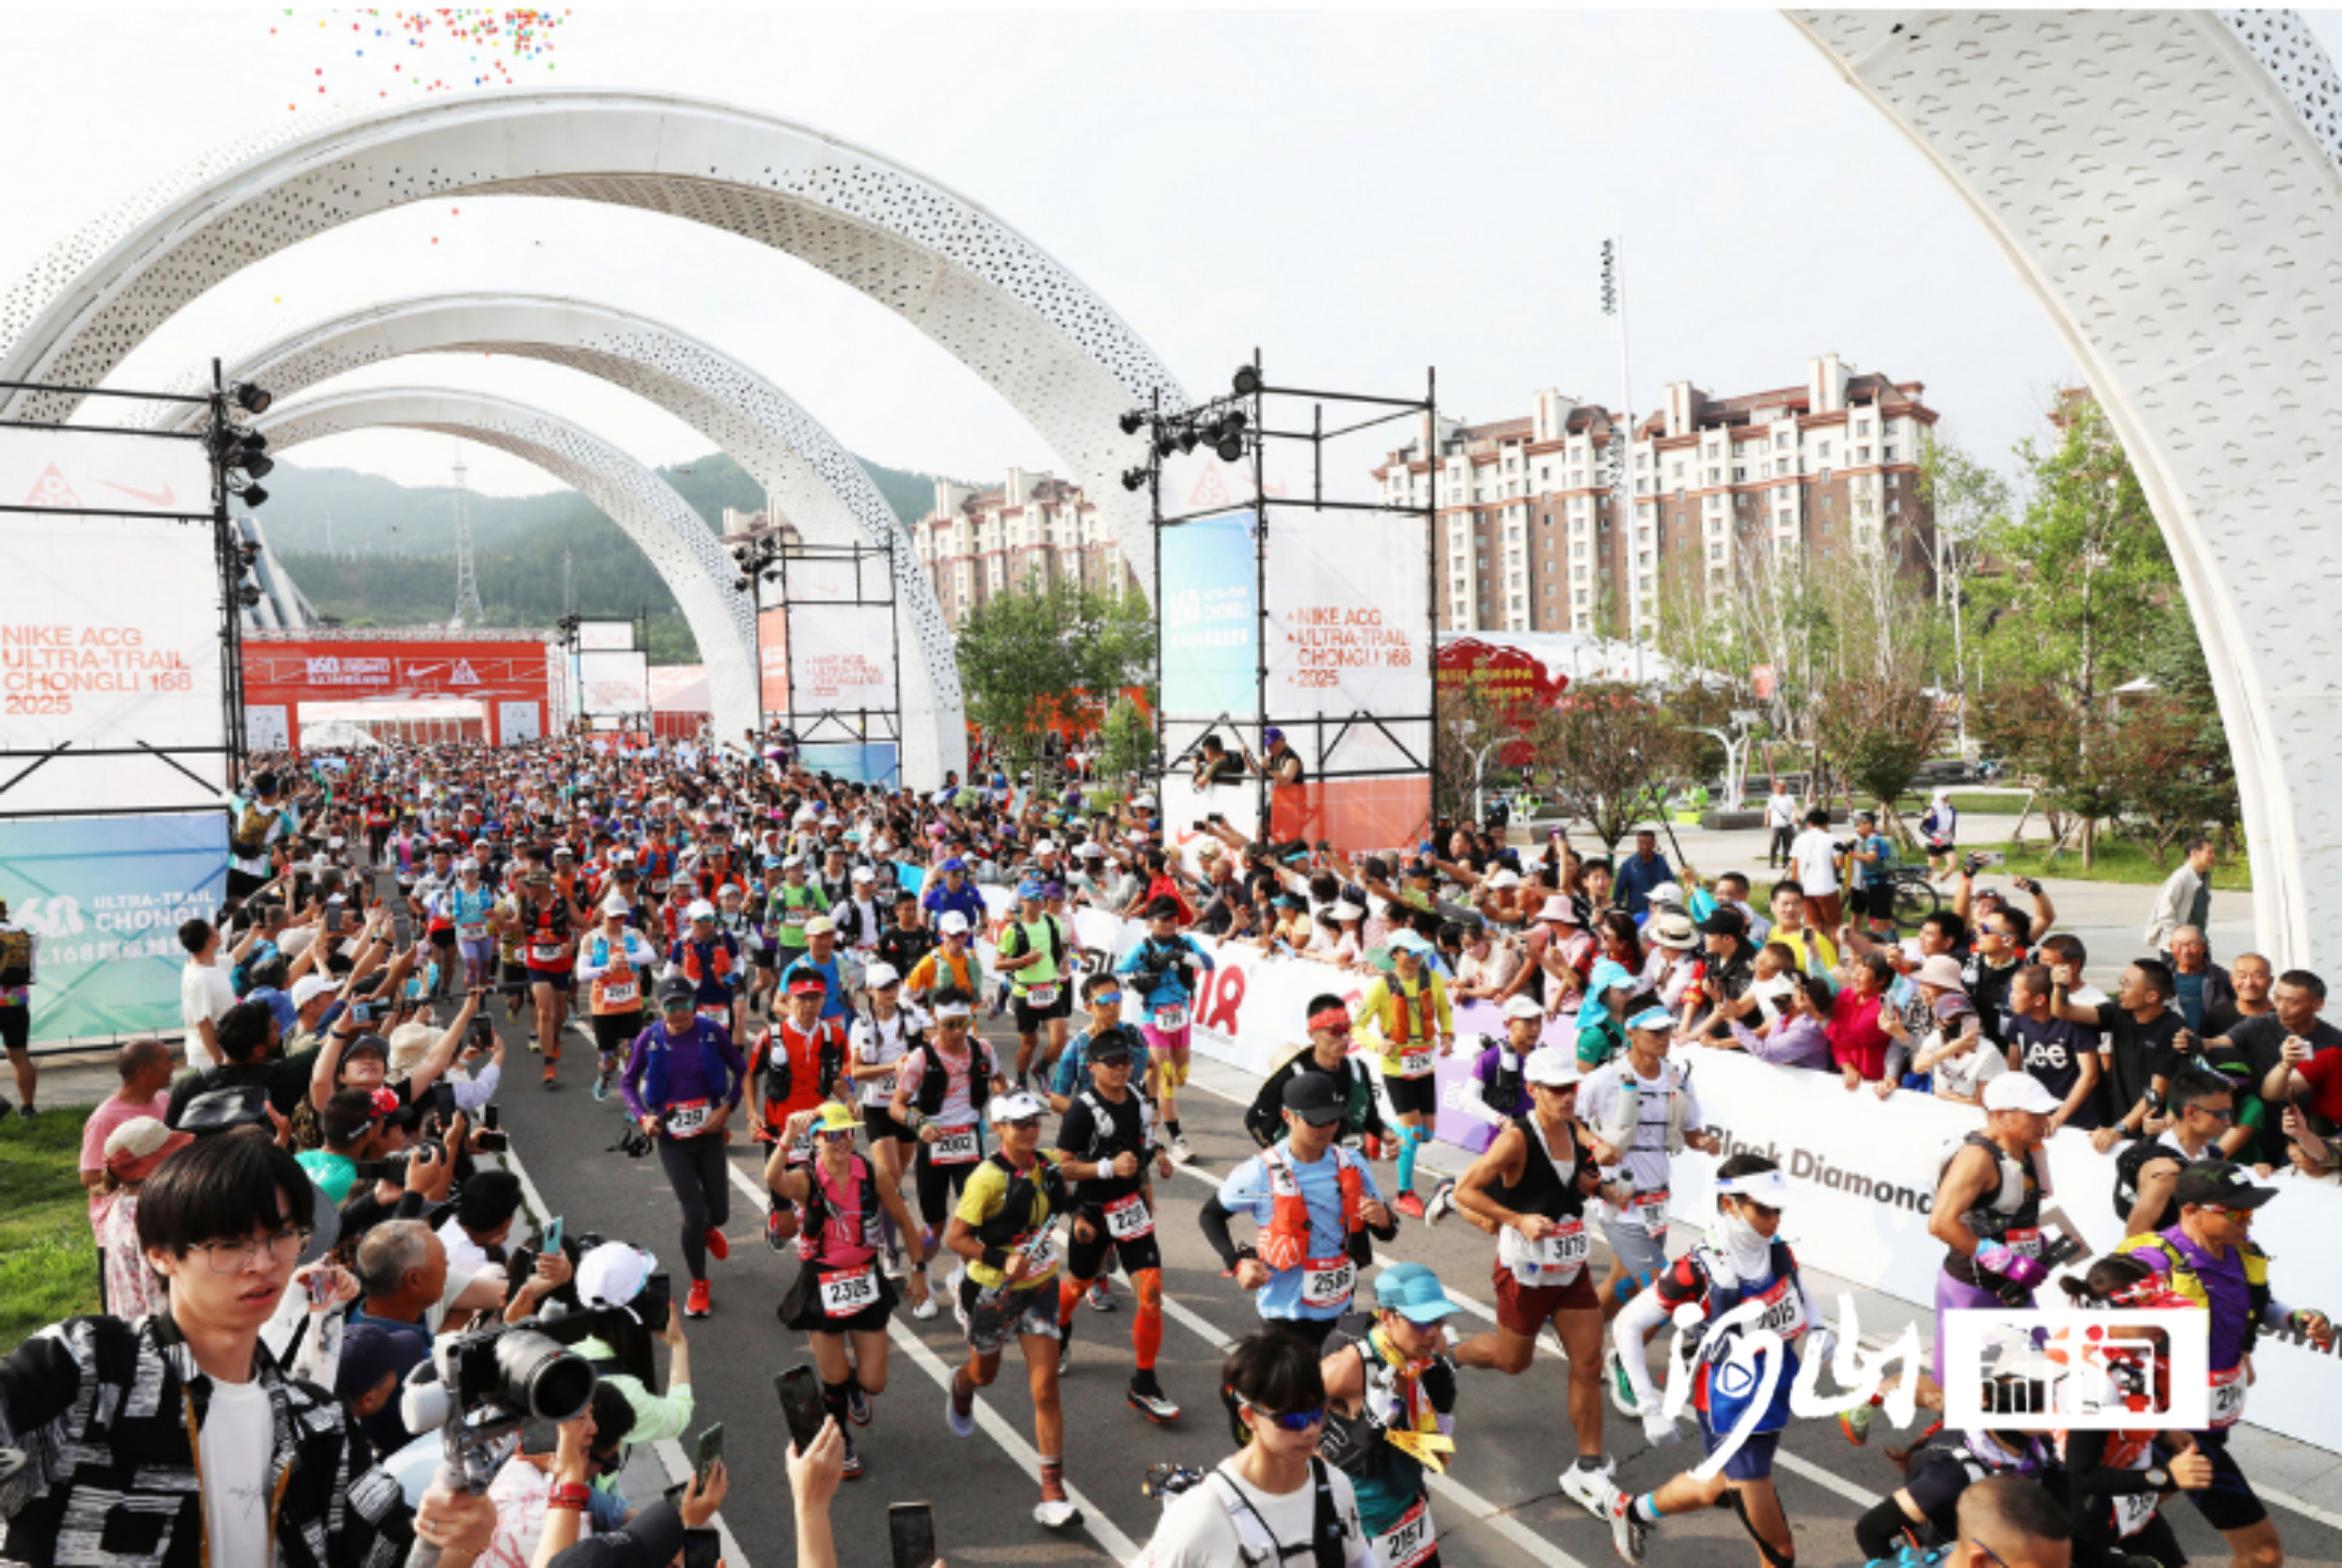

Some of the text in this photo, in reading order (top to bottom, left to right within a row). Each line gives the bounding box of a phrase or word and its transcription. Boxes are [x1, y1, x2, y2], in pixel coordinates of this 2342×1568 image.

[1297, 606, 1382, 626] NIKE ACG
[2, 625, 143, 647] NIKE ACG
[1297, 627, 1410, 647] ULTRA-TRAIL
[2, 648, 191, 670] ULTRA-TRAIL
[1297, 648, 1412, 667] CHONGLI 168
[3, 671, 194, 692] CHONGLI 168
[1297, 669, 1340, 688] 2025
[5, 694, 73, 715] 2025
[94, 889, 216, 909] ULTRA-TRAIL
[2017, 1032, 2069, 1069] Lee
